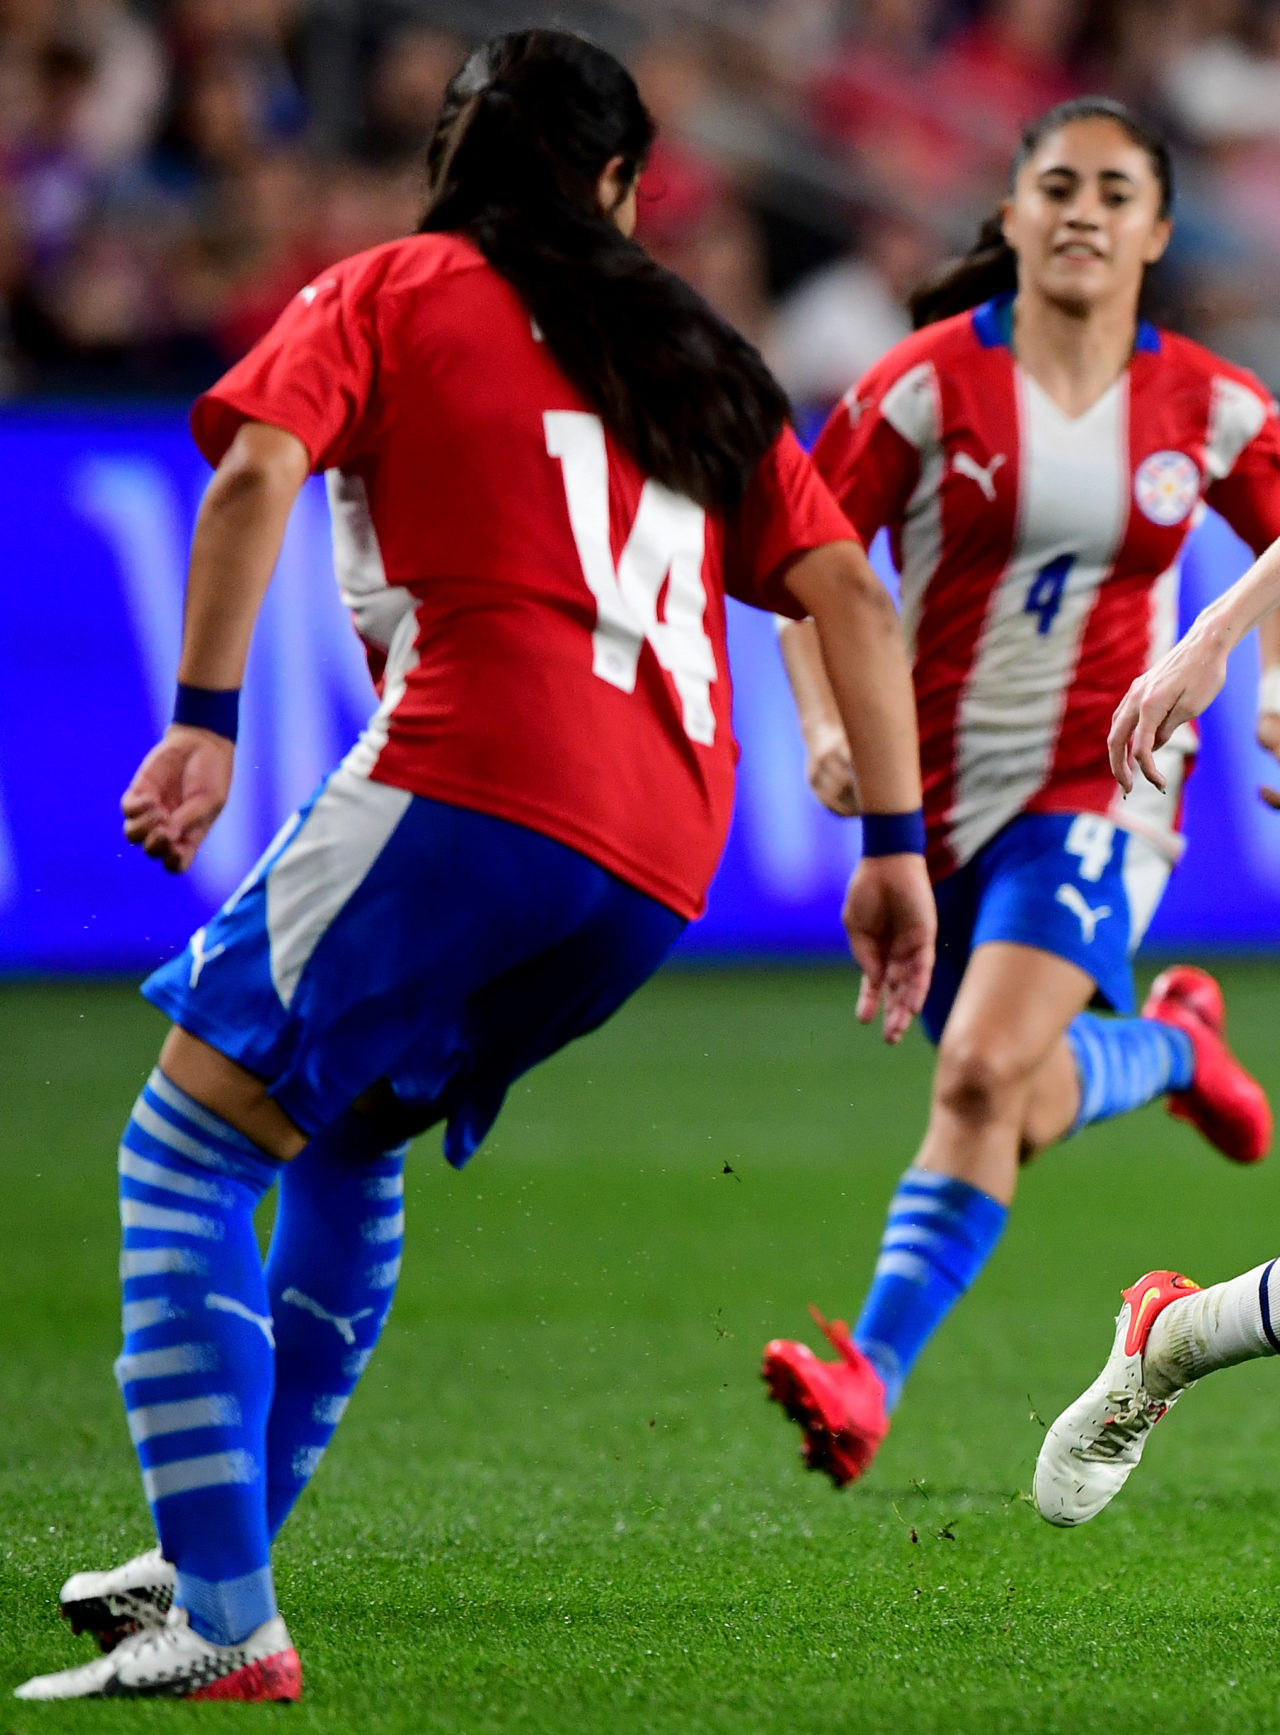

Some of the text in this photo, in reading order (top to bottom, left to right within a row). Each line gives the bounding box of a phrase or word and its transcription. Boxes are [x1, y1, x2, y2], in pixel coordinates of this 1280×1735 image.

[542, 410, 717, 746] 14
[1025, 553, 1077, 635] 4
[1064, 813, 1112, 880] 4
